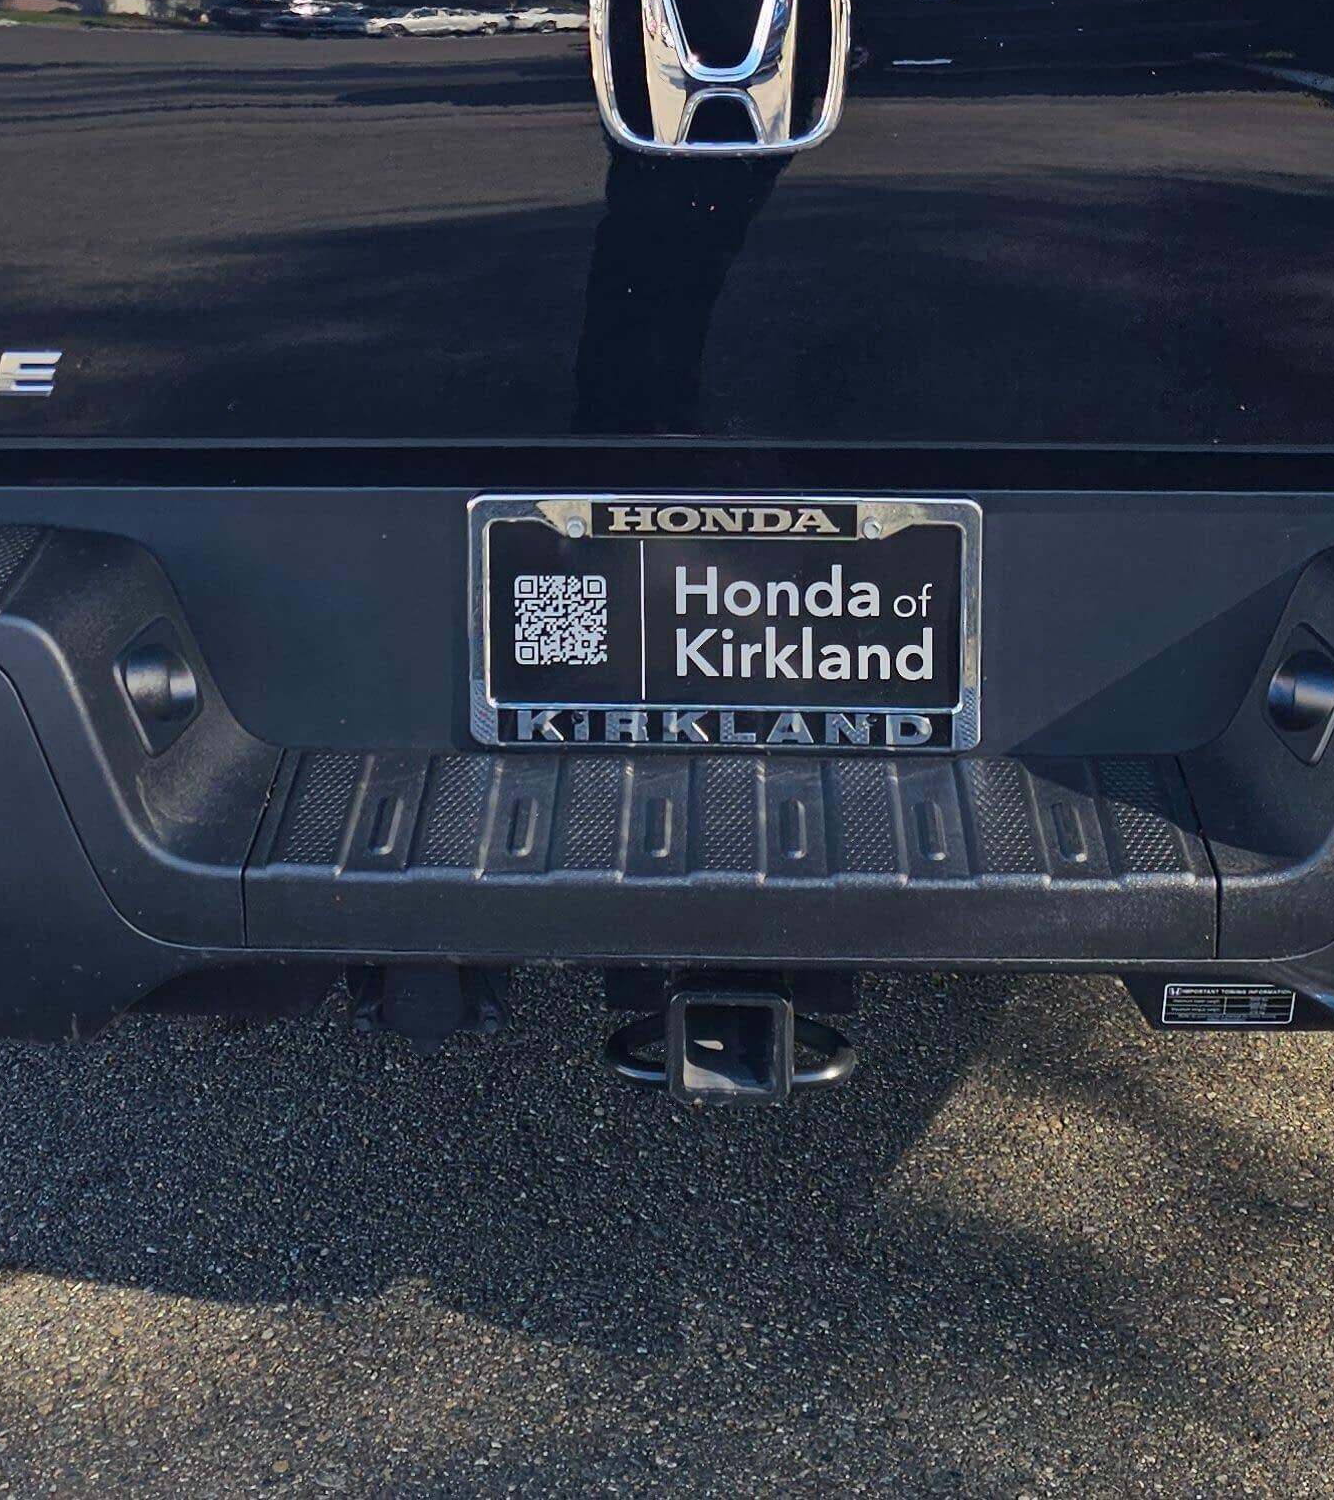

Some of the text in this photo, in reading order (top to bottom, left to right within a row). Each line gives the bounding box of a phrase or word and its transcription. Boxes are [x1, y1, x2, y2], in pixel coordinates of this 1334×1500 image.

[608, 505, 840, 534] HONDA
[674, 564, 933, 618] Honda of
[675, 626, 934, 681] Kirkland
[515, 710, 934, 745] KIRKLAND
